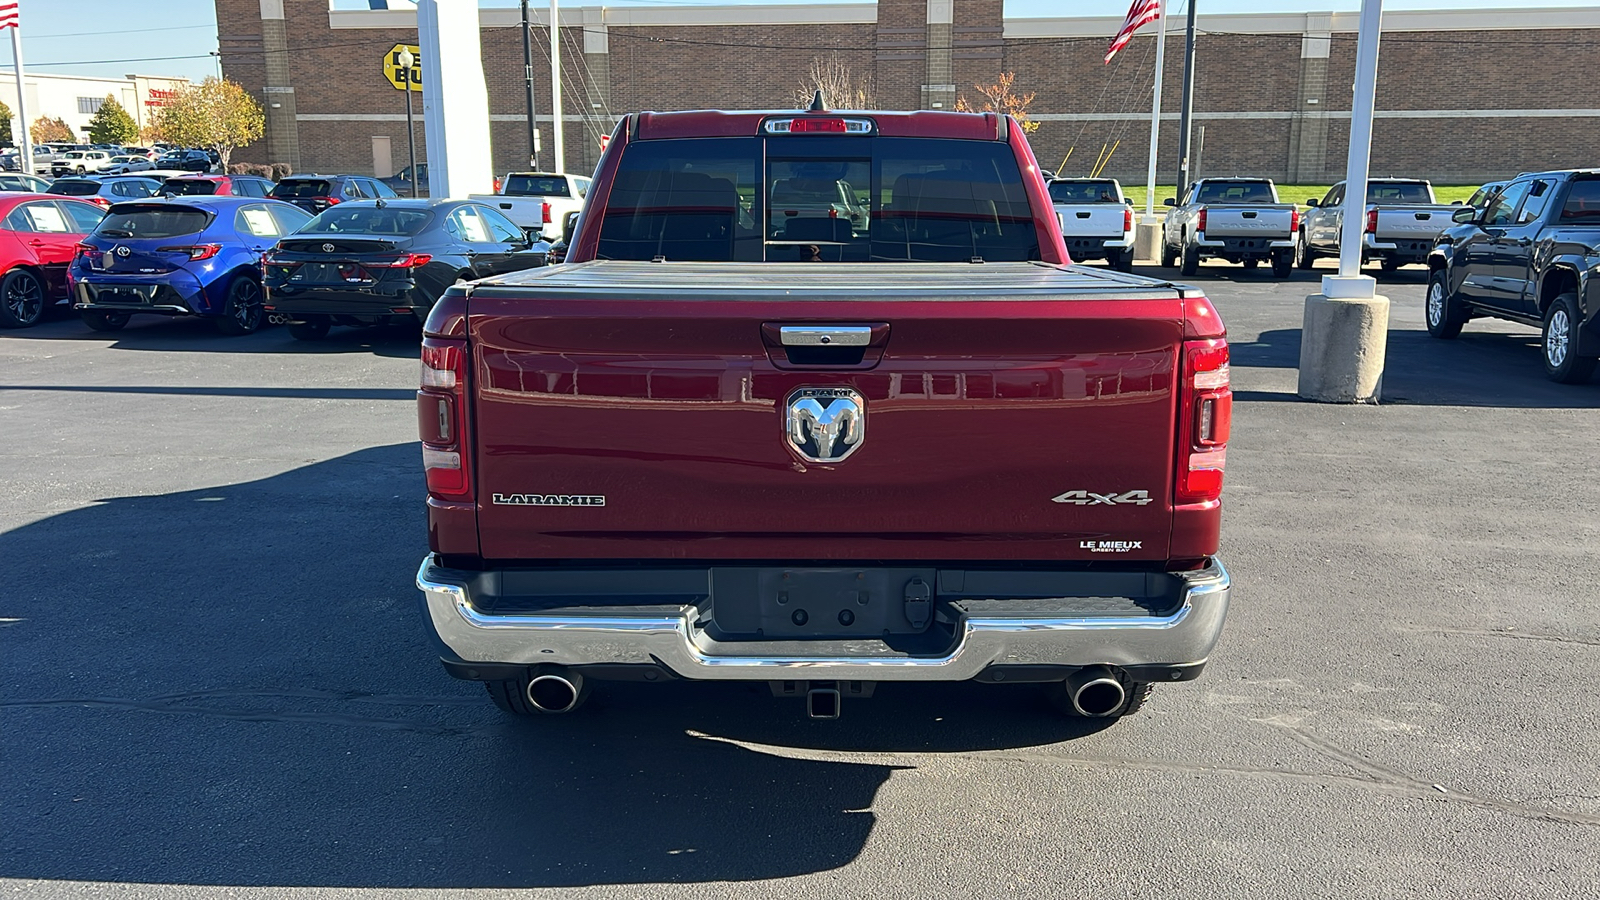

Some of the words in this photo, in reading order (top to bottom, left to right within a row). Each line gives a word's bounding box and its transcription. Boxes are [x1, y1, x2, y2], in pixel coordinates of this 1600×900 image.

[492, 493, 606, 507] LARAMIE
[1051, 490, 1154, 506] 4x4
[1080, 541, 1096, 549] LE
[1099, 541, 1142, 549] MIEUX
